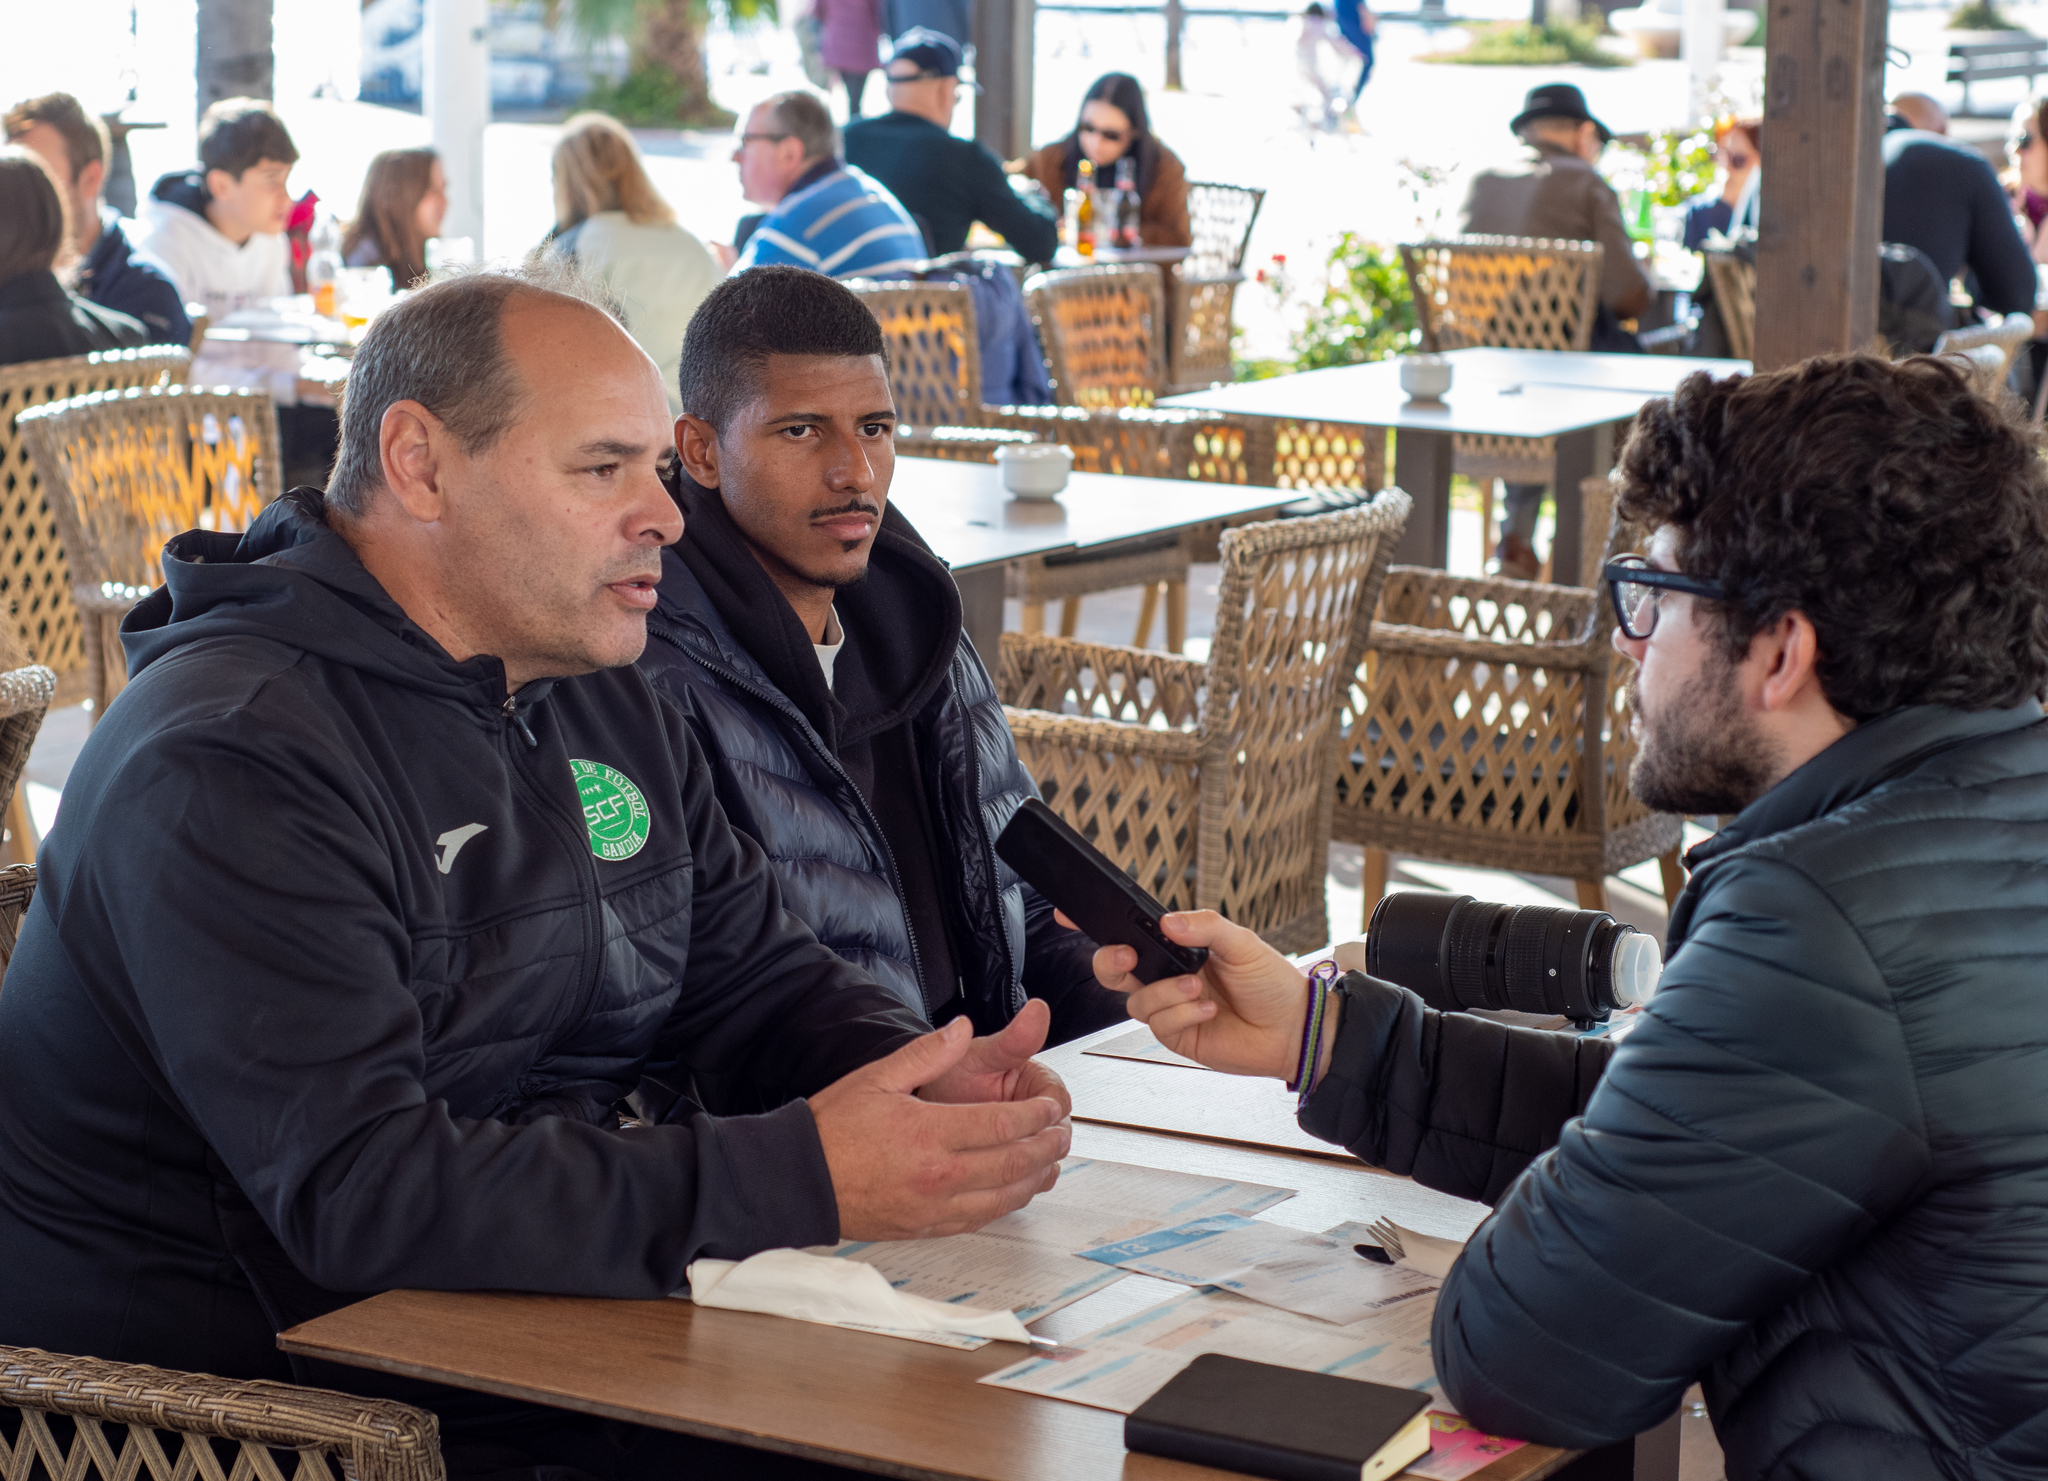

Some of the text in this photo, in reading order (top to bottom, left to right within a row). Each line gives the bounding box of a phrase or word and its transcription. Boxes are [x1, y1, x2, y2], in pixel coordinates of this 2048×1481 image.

[578, 761, 598, 775] DE
[605, 768, 646, 819] FÚTBOL
[602, 831, 644, 857] GANDIA
